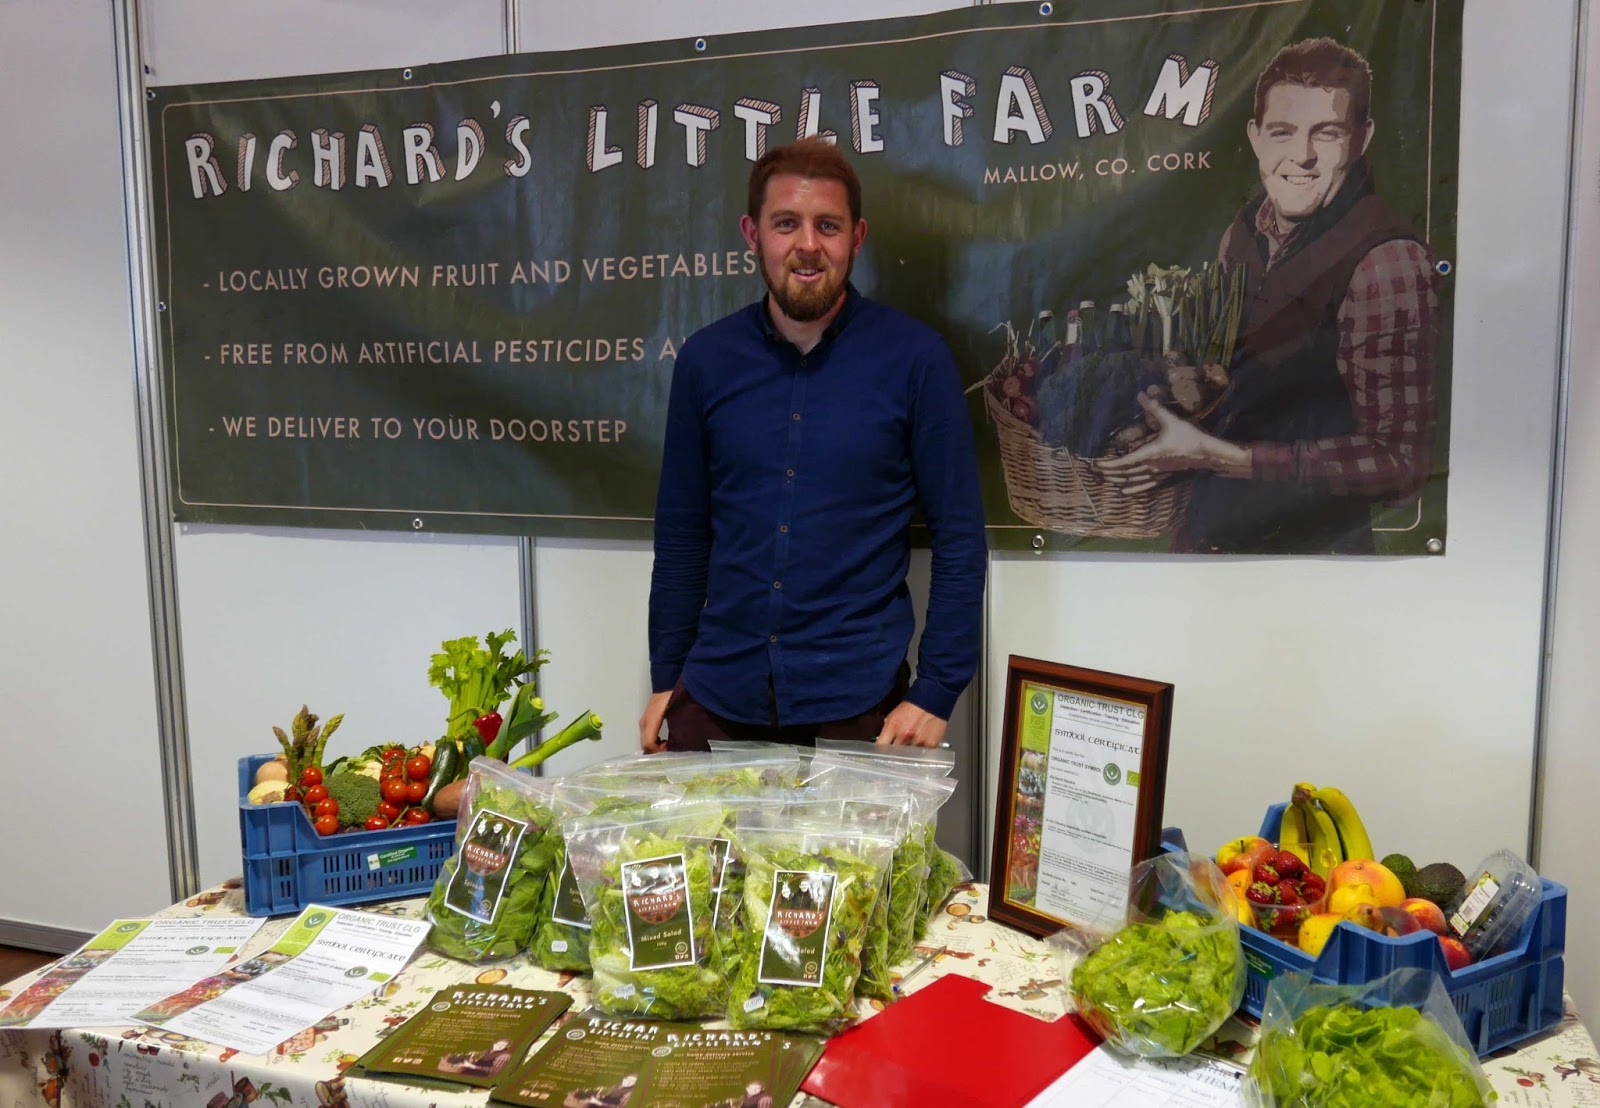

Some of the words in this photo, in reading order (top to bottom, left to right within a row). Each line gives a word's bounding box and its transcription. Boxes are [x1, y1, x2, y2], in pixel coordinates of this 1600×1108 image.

[185, 100, 532, 199] RICHARD'S
[586, 79, 884, 173] LITTLE
[939, 52, 1220, 147] FARM
[984, 161, 1084, 184] MALLOW,
[1095, 157, 1135, 177] CO.
[1147, 151, 1211, 172] CORK
[219, 267, 308, 292] LOCALLY
[318, 265, 419, 289] GROWN
[432, 262, 499, 287] FRUIT
[510, 260, 571, 284] AND
[582, 250, 756, 282] VEGETABLES
[220, 343, 272, 365] FREE
[284, 342, 348, 365] FROM
[358, 340, 482, 364] ARTIFICIAL
[494, 337, 645, 363] PESTICIDES
[222, 416, 257, 437] WE
[268, 416, 360, 439] DELIVER
[371, 417, 402, 439] TO
[413, 417, 479, 440] YOUR
[490, 418, 627, 443] DOORSTEP
[1058, 693, 1095, 709] ORGANIC
[1097, 702, 1124, 715] TRUST
[1126, 708, 1144, 719] CLG
[338, 913, 375, 925] ORGANIC
[376, 919, 403, 930] TRUST
[402, 925, 420, 934] CLG
[641, 933, 661, 942] Mixed
[663, 929, 681, 938] Salad
[452, 991, 548, 1006] RICHARD'S
[454, 999, 494, 1007] LITTLE
[500, 1000, 534, 1010] FARM
[588, 1018, 659, 1034] RICHAR
[589, 1028, 631, 1038] LITTLE
[667, 1032, 771, 1043] RICHARD'S
